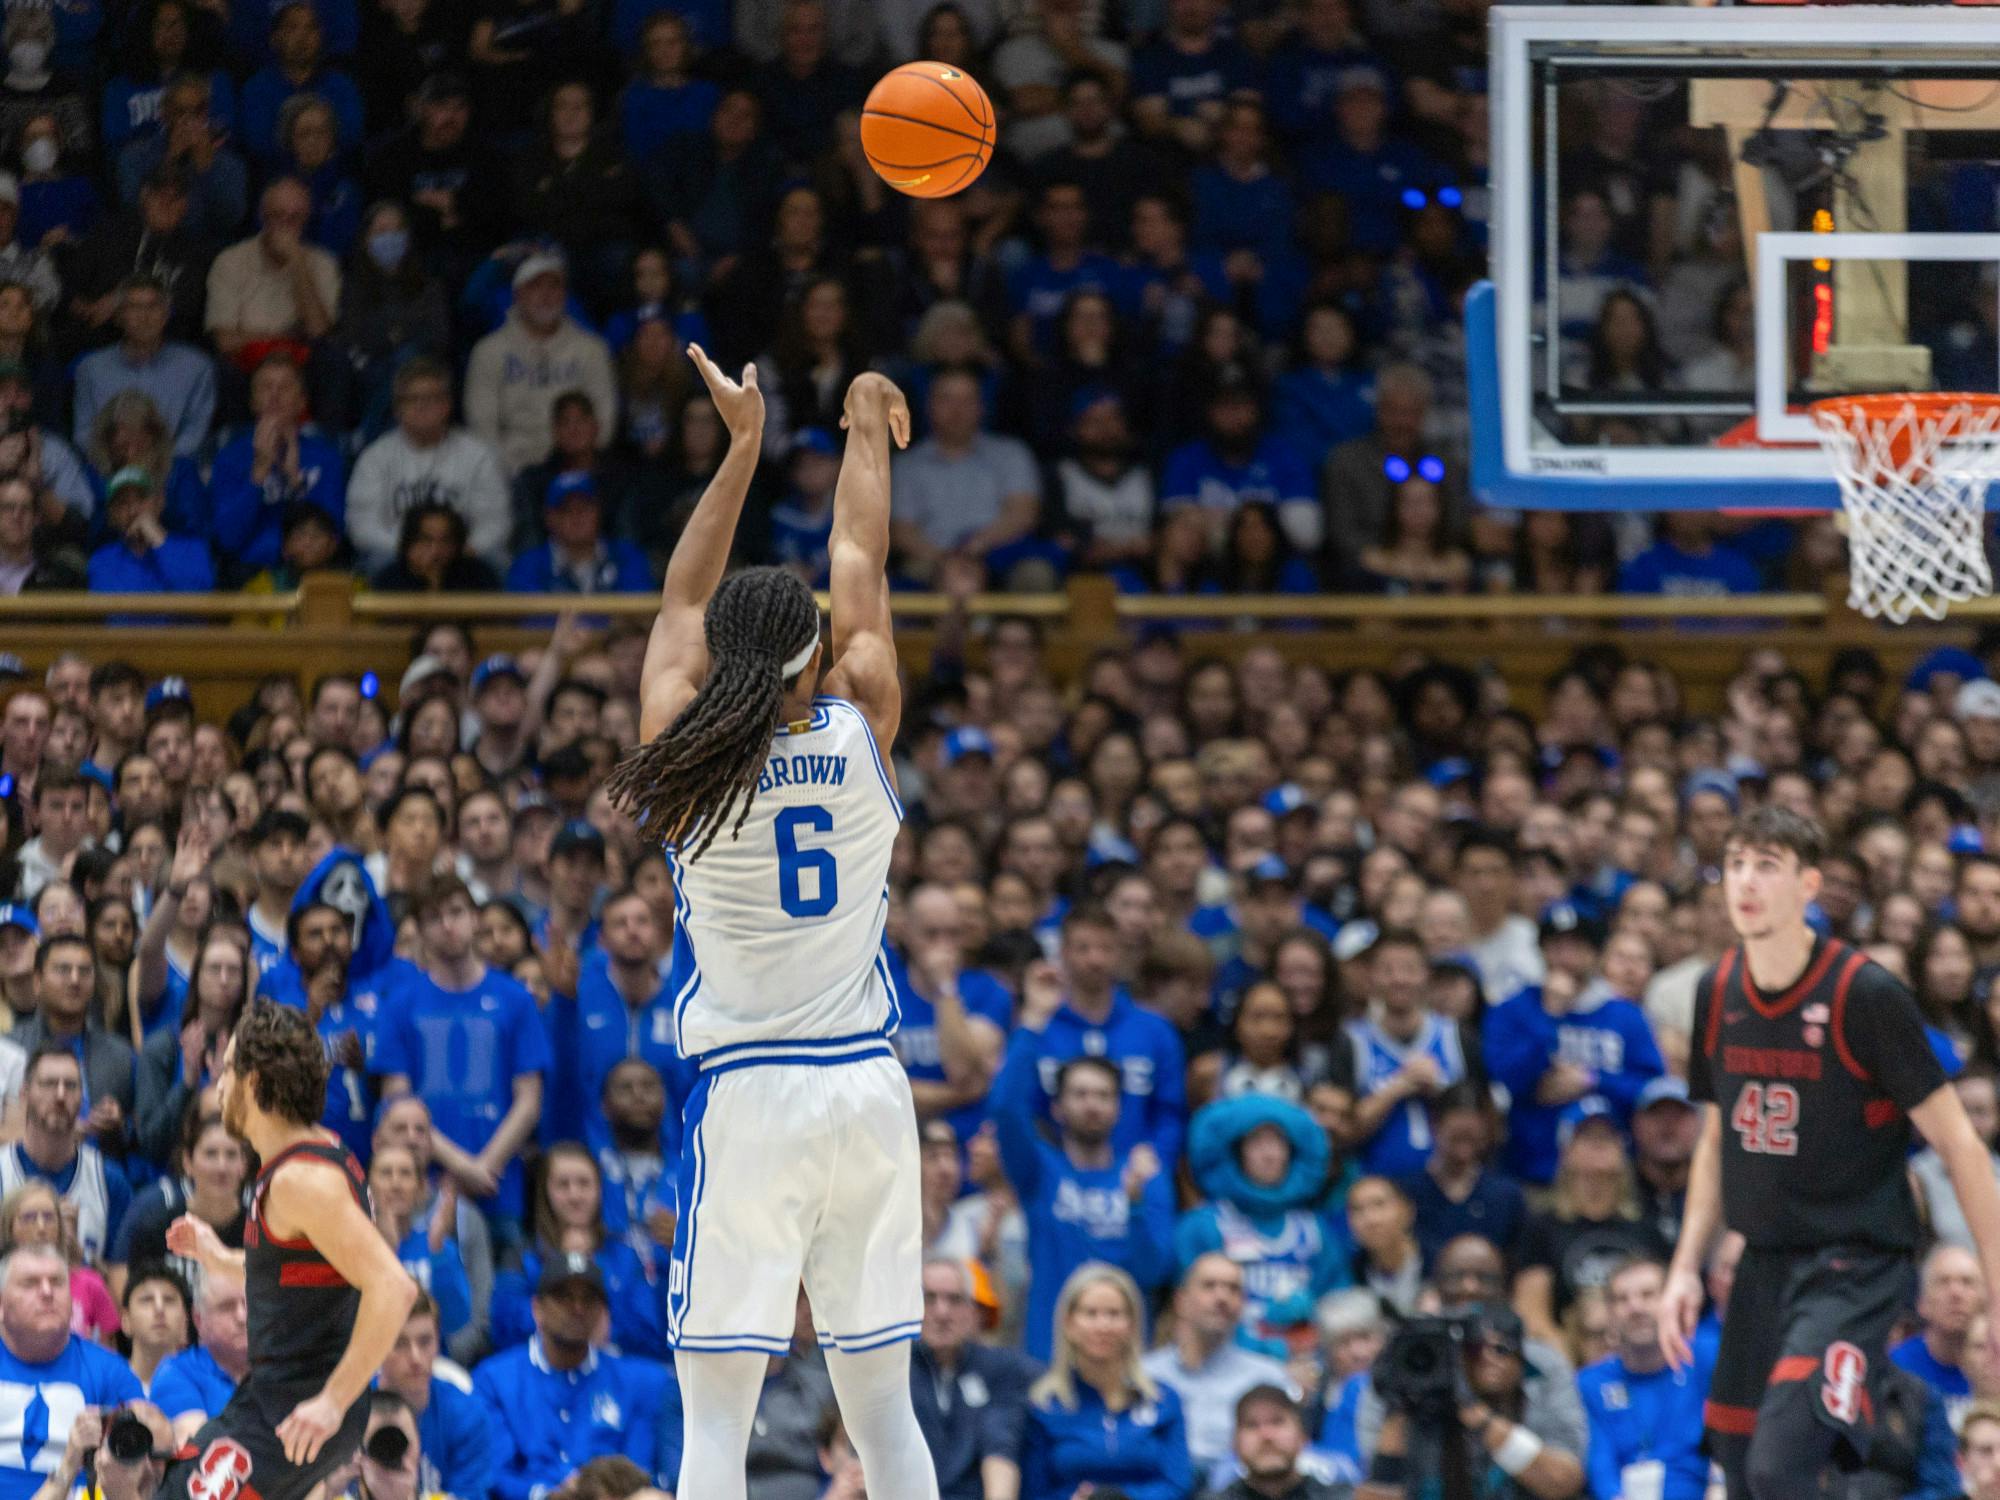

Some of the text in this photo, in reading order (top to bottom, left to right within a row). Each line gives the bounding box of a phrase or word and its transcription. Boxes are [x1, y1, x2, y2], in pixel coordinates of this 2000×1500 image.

[759, 754, 848, 793] BROWN
[775, 804, 839, 918] 6
[1731, 1081, 1800, 1156] 42
